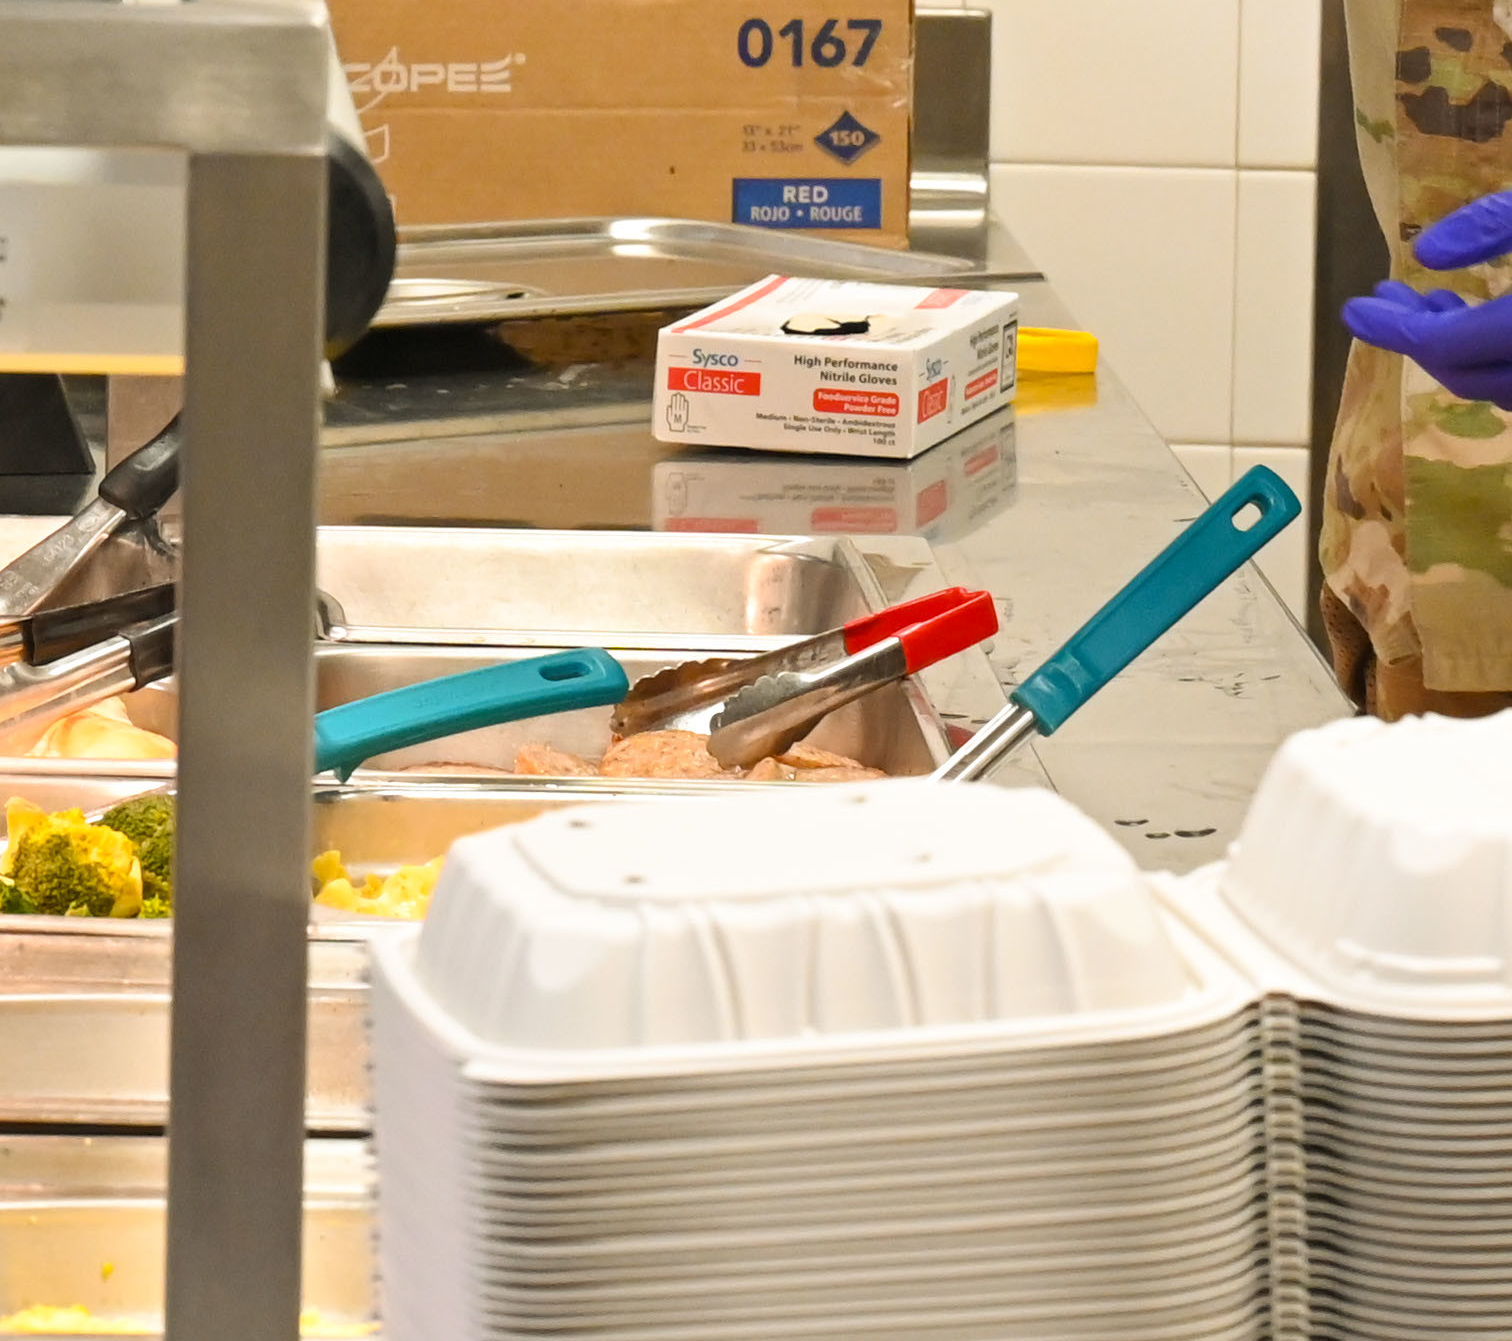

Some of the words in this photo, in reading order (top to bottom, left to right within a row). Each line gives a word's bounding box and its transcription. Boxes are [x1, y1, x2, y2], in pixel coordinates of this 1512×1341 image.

[738, 18, 882, 68] 0167
[829, 130, 865, 147] 150
[783, 186, 829, 203] RED
[750, 206, 790, 222] ROJO
[810, 206, 863, 222] ROUGE
[693, 349, 739, 367] Sysco
[794, 355, 821, 368] High
[824, 357, 898, 372] Performance
[684, 370, 745, 393] Classic
[820, 371, 856, 383] Nitrile
[859, 373, 897, 385] Gloves
[674, 413, 682, 423] M
